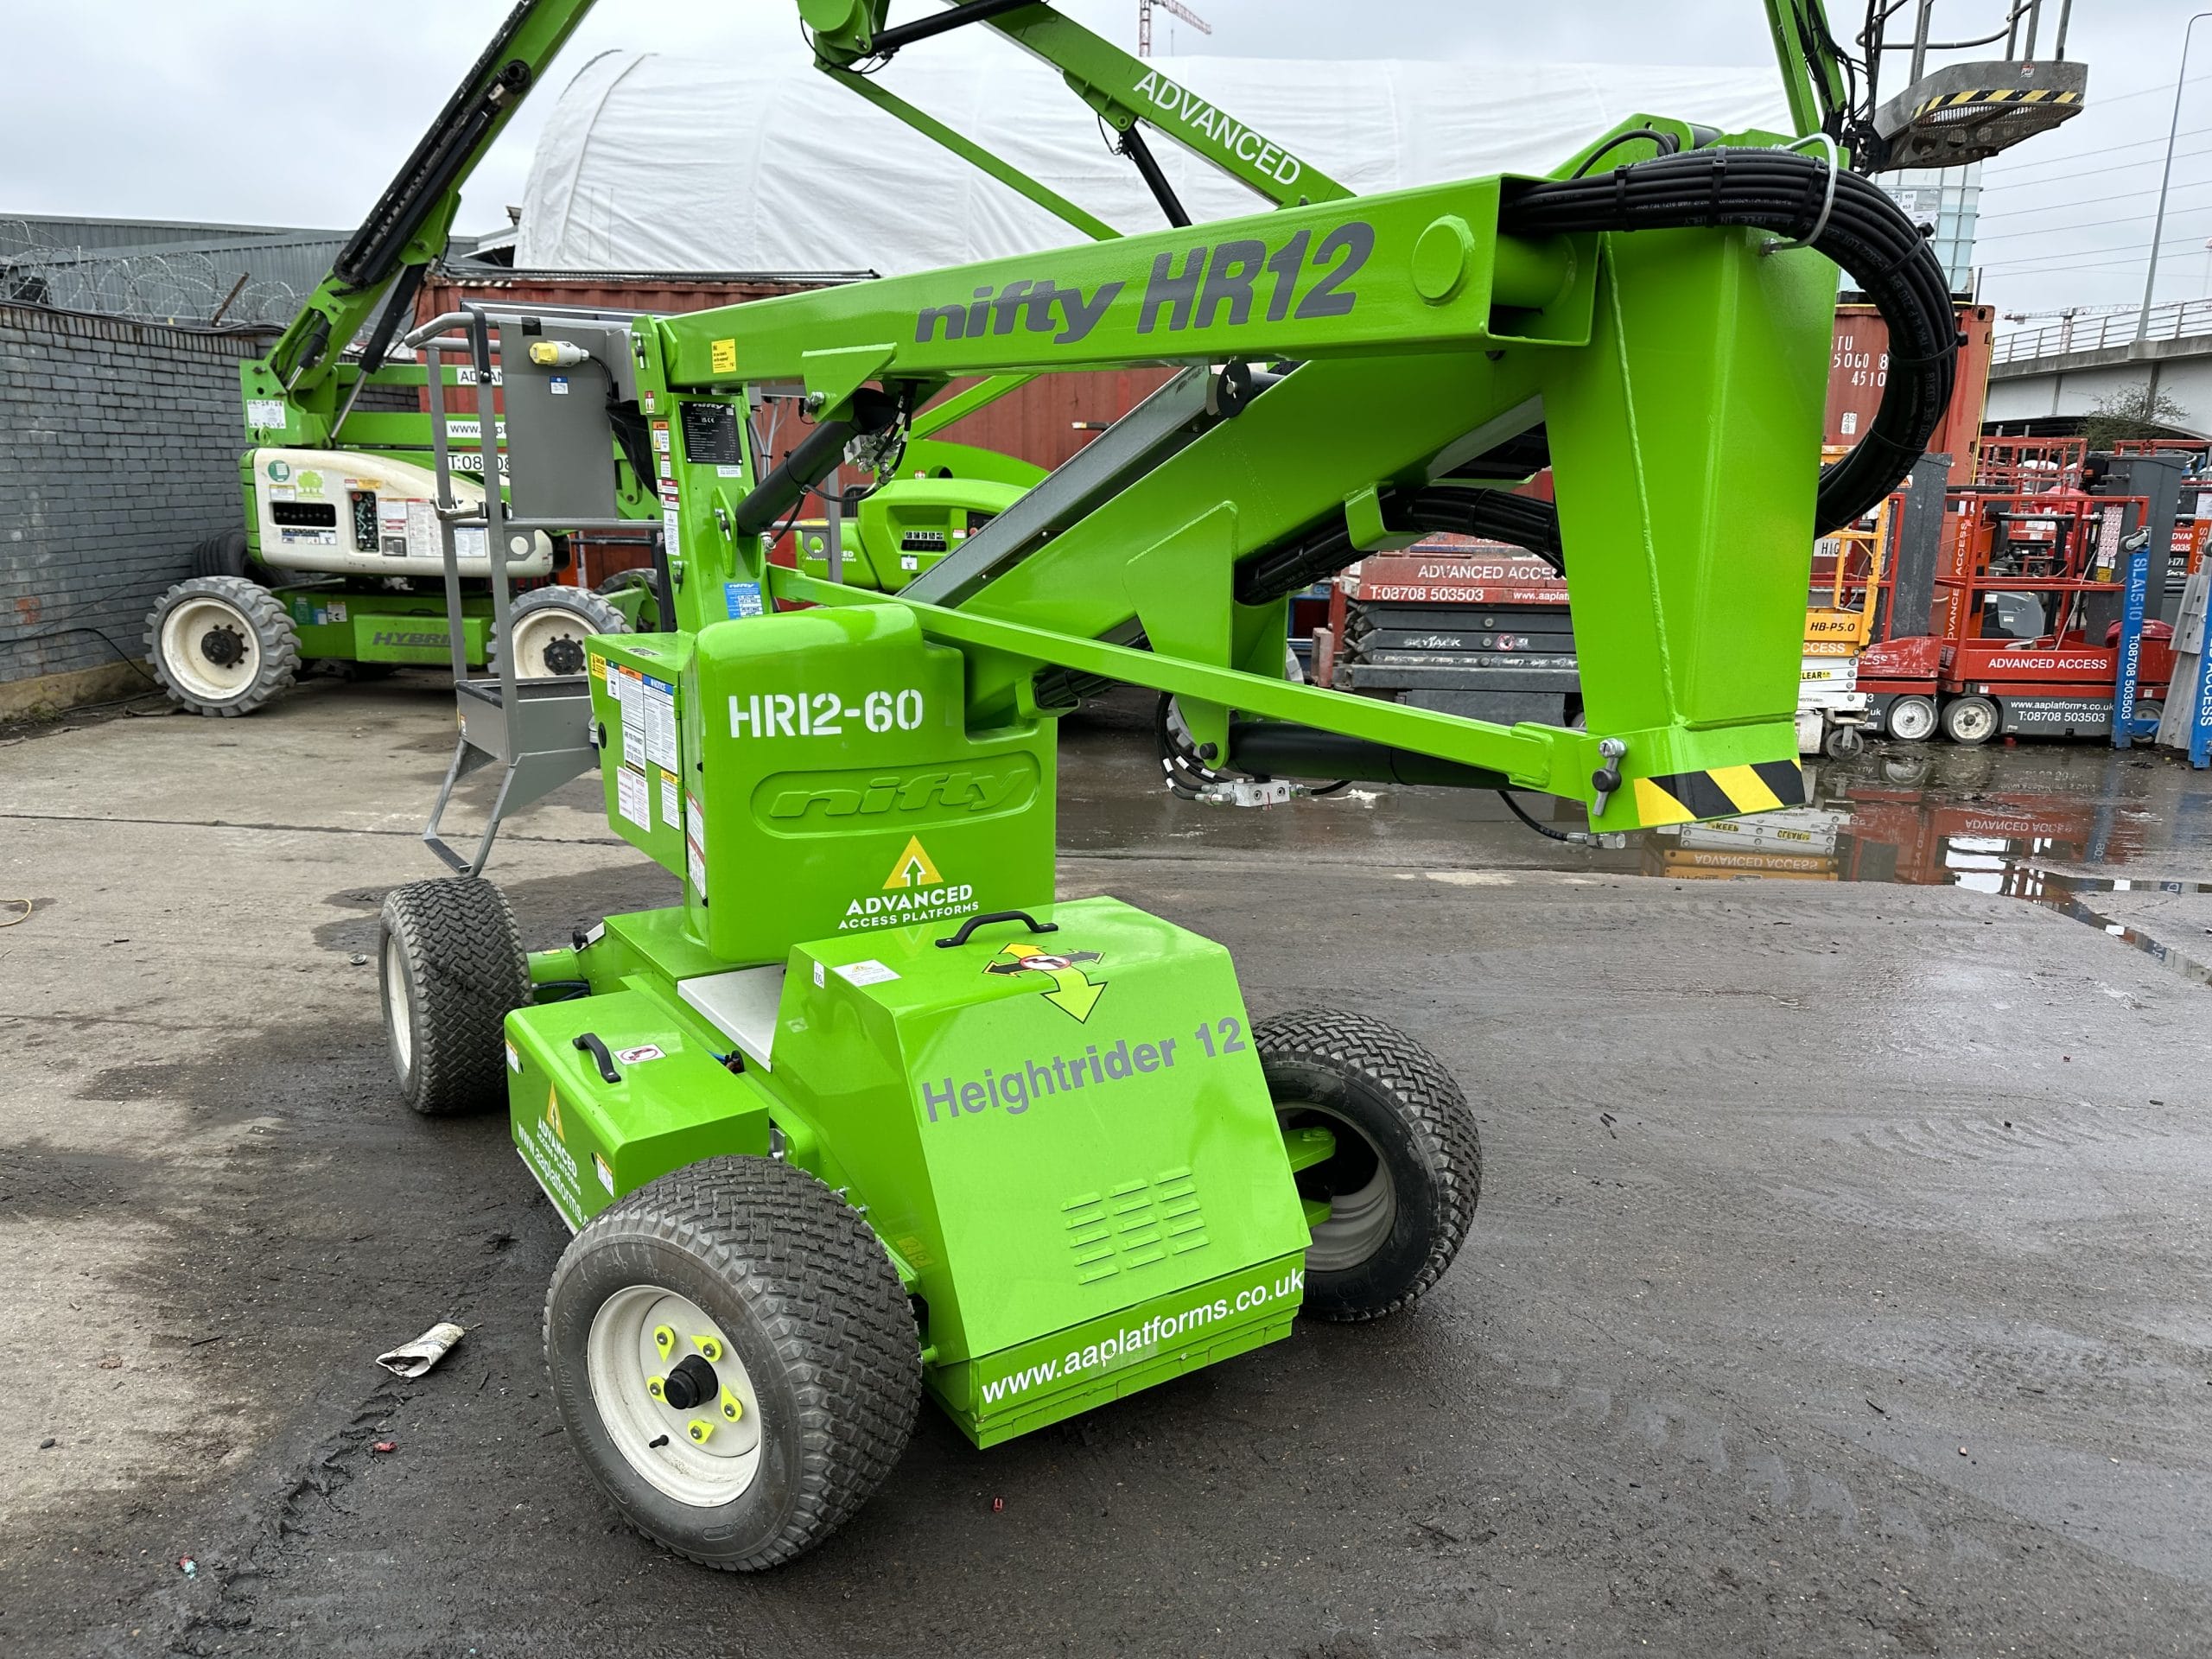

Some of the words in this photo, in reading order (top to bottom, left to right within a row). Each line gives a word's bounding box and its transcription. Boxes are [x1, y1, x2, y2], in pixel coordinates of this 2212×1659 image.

[1133, 70, 1301, 185] ADVANCED
[915, 280, 1126, 345] nifty
[1137, 221, 1376, 334] HR12
[1832, 335, 1853, 351] TU
[1878, 354, 1888, 370] 8
[1851, 371, 1886, 387] 4510
[1821, 542, 1840, 556] HIG
[2194, 526, 2209, 575] CCESS
[1418, 565, 1503, 580] ADVANCED
[1947, 587, 1961, 640] DVANCE
[1955, 522, 1968, 576] ACCESS
[1370, 586, 1427, 601] T:08708
[1430, 587, 1484, 601] 503503
[1809, 621, 1855, 632] HB-P5.0
[372, 631, 467, 646] HYBRI
[1803, 642, 1846, 654] CCESS
[2126, 632, 2140, 677] T:08708
[1988, 658, 2055, 669] ADVANCED
[2056, 658, 2107, 670] ACCESS
[1801, 671, 1822, 680] LEAR
[2011, 701, 2114, 711] www.aaplatforms.co.uk
[2121, 678, 2135, 720] 503503
[2018, 710, 2062, 722] T:08708
[2063, 712, 2106, 723] 503503
[768, 767, 1030, 819] nifty
[845, 883, 974, 917] ADVANCED
[837, 913, 897, 930] ACCESS
[902, 901, 979, 924] PLATFORMS
[922, 1036, 1177, 1122] Heightrider
[1194, 1016, 1247, 1059] 12
[538, 1115, 577, 1179] ADVANCED
[981, 1268, 1304, 1404] www.aaplatforms.co.uk
